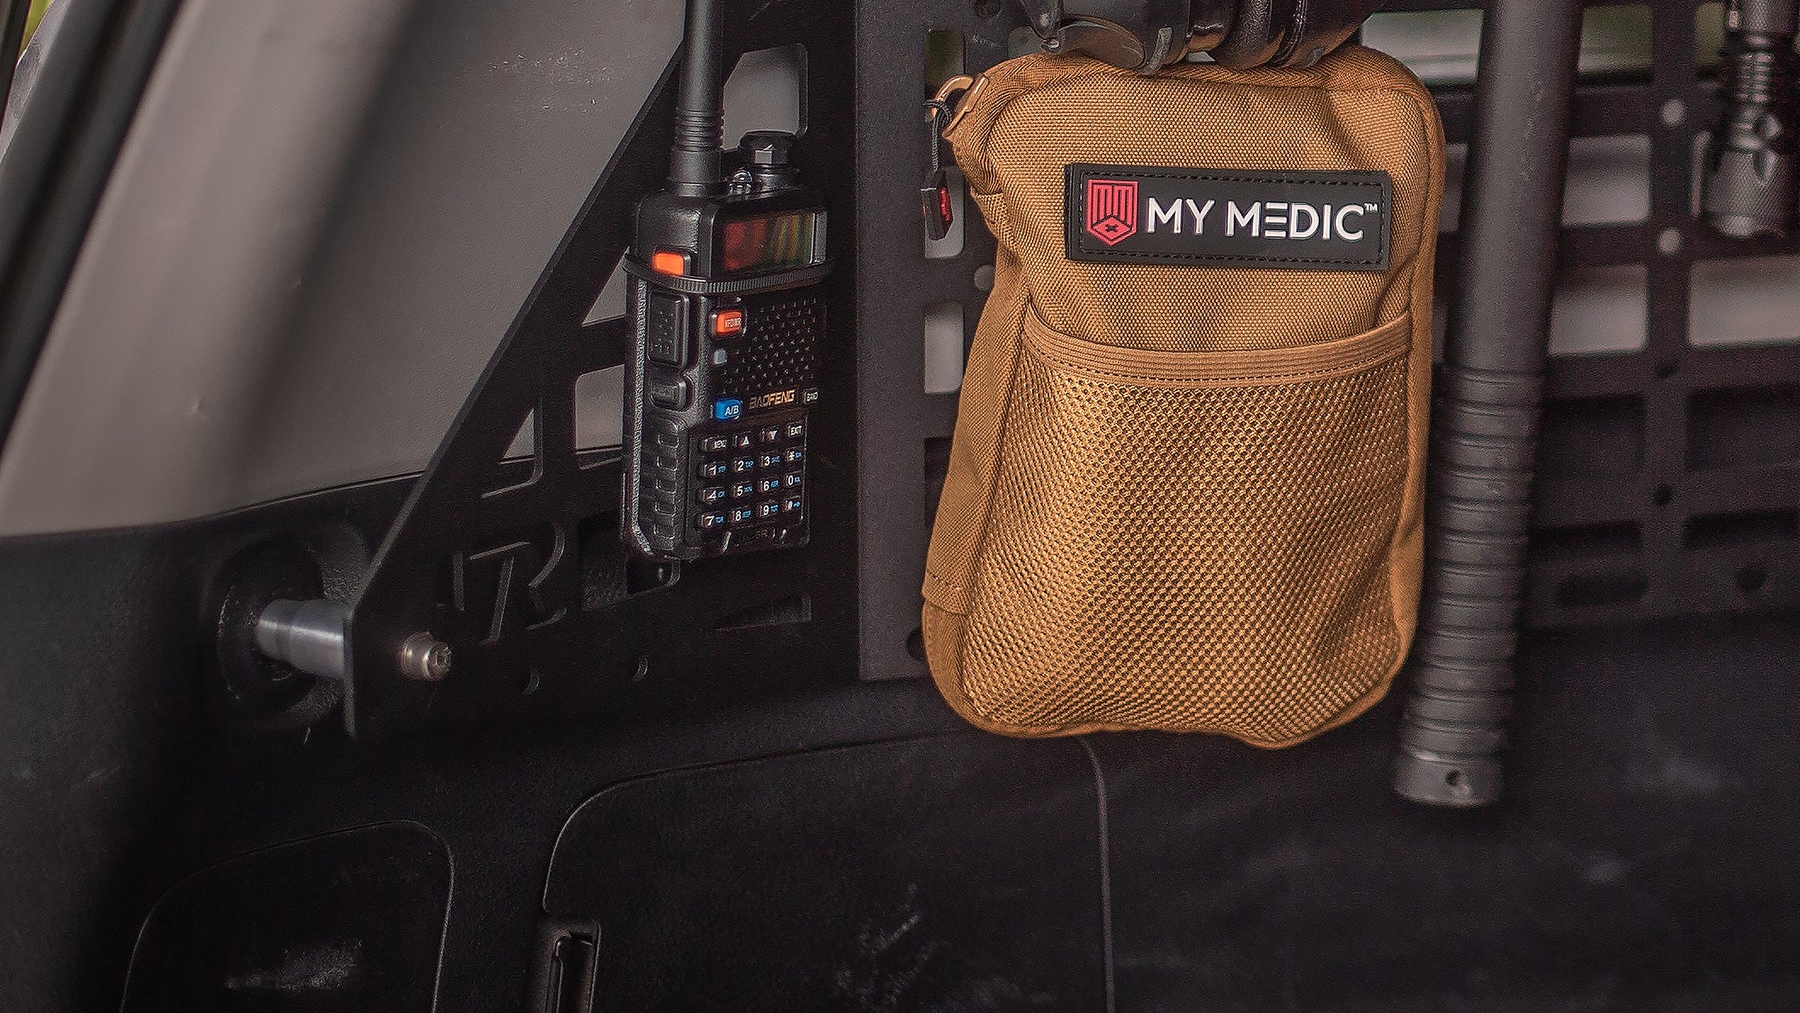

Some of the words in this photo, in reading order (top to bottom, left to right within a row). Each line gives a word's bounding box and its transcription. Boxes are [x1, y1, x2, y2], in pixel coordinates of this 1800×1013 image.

[1146, 196, 1216, 236] MY
[748, 388, 796, 409] BAOFENG
[724, 404, 740, 417] A/B
